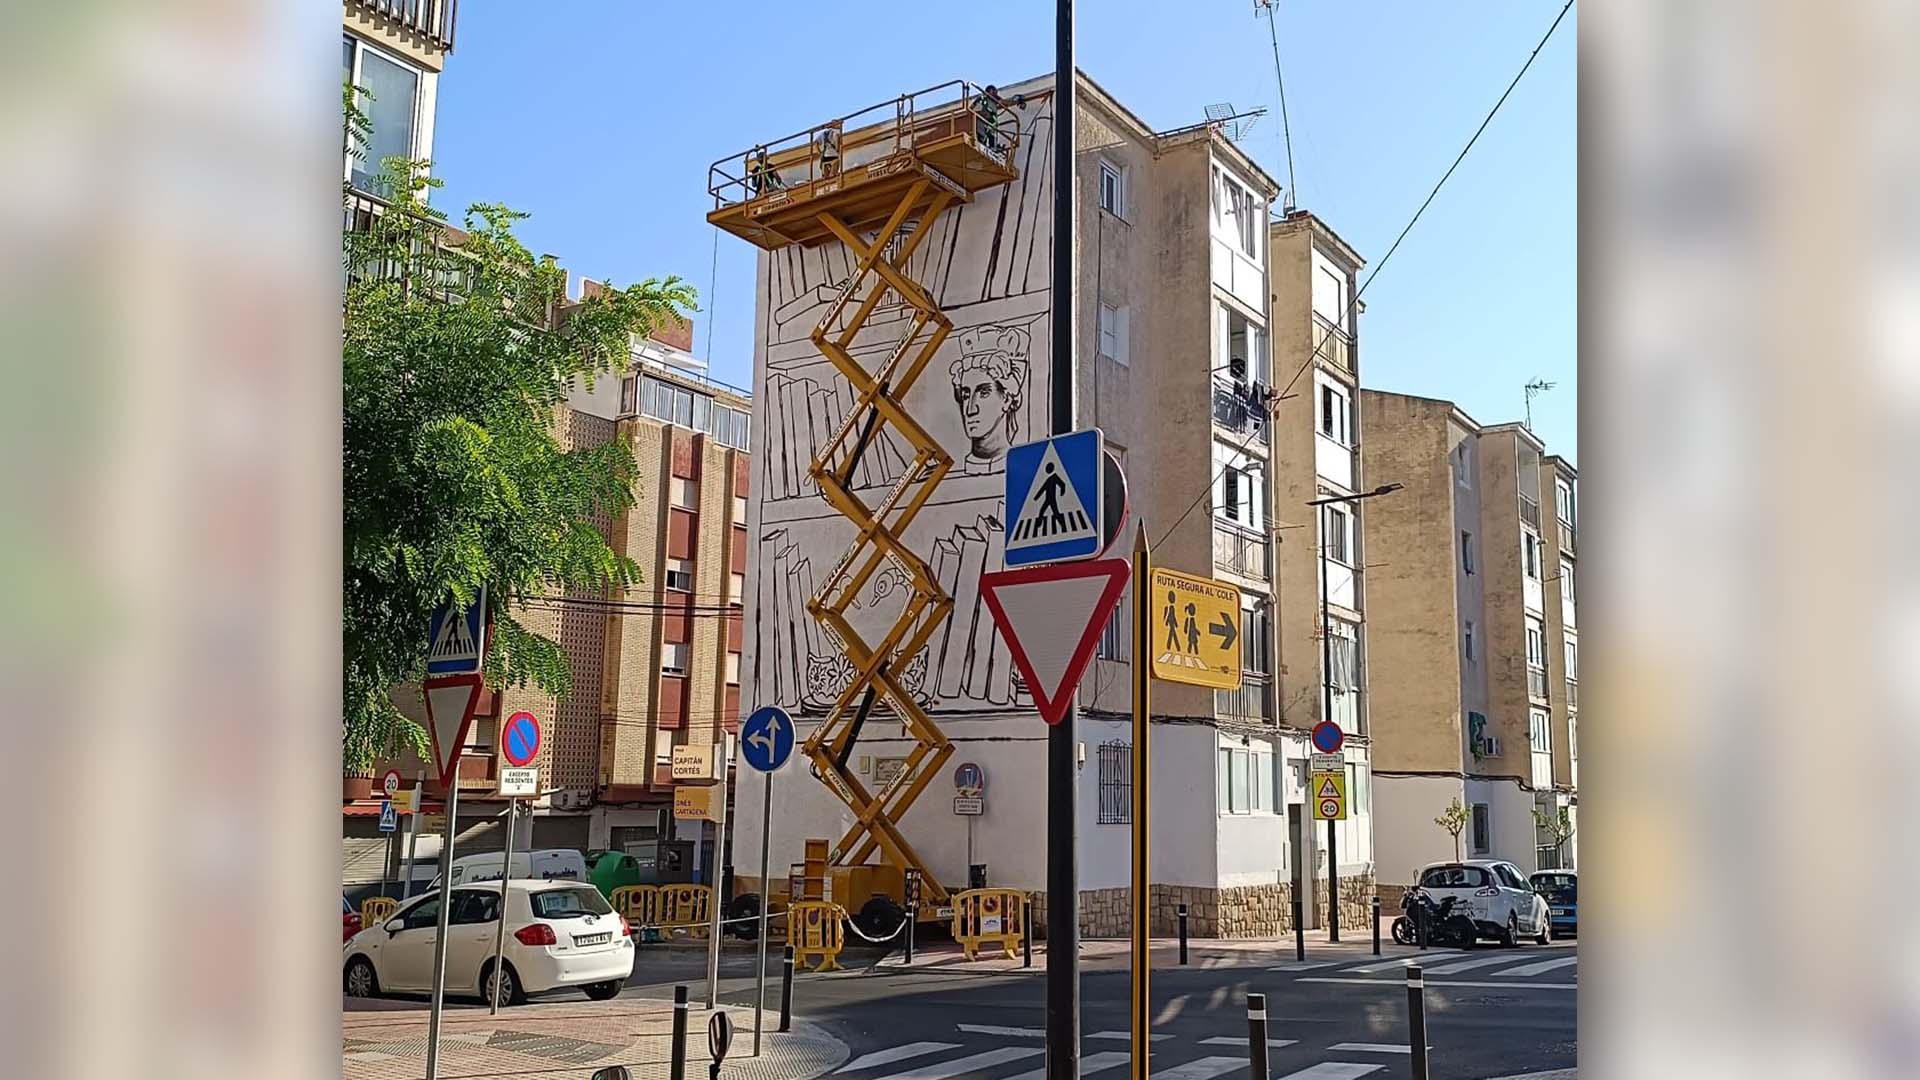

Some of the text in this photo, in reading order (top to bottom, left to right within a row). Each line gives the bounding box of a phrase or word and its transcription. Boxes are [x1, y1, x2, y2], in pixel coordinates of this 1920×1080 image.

[1157, 575, 1176, 588] RUTA
[1177, 580, 1204, 594] SEGURA
[1205, 587, 1214, 596] AL
[674, 756, 702, 765] CAPITÁN
[673, 766, 700, 775] CORTÉS
[386, 779, 396, 790] 20
[1324, 804, 1336, 813] 20
